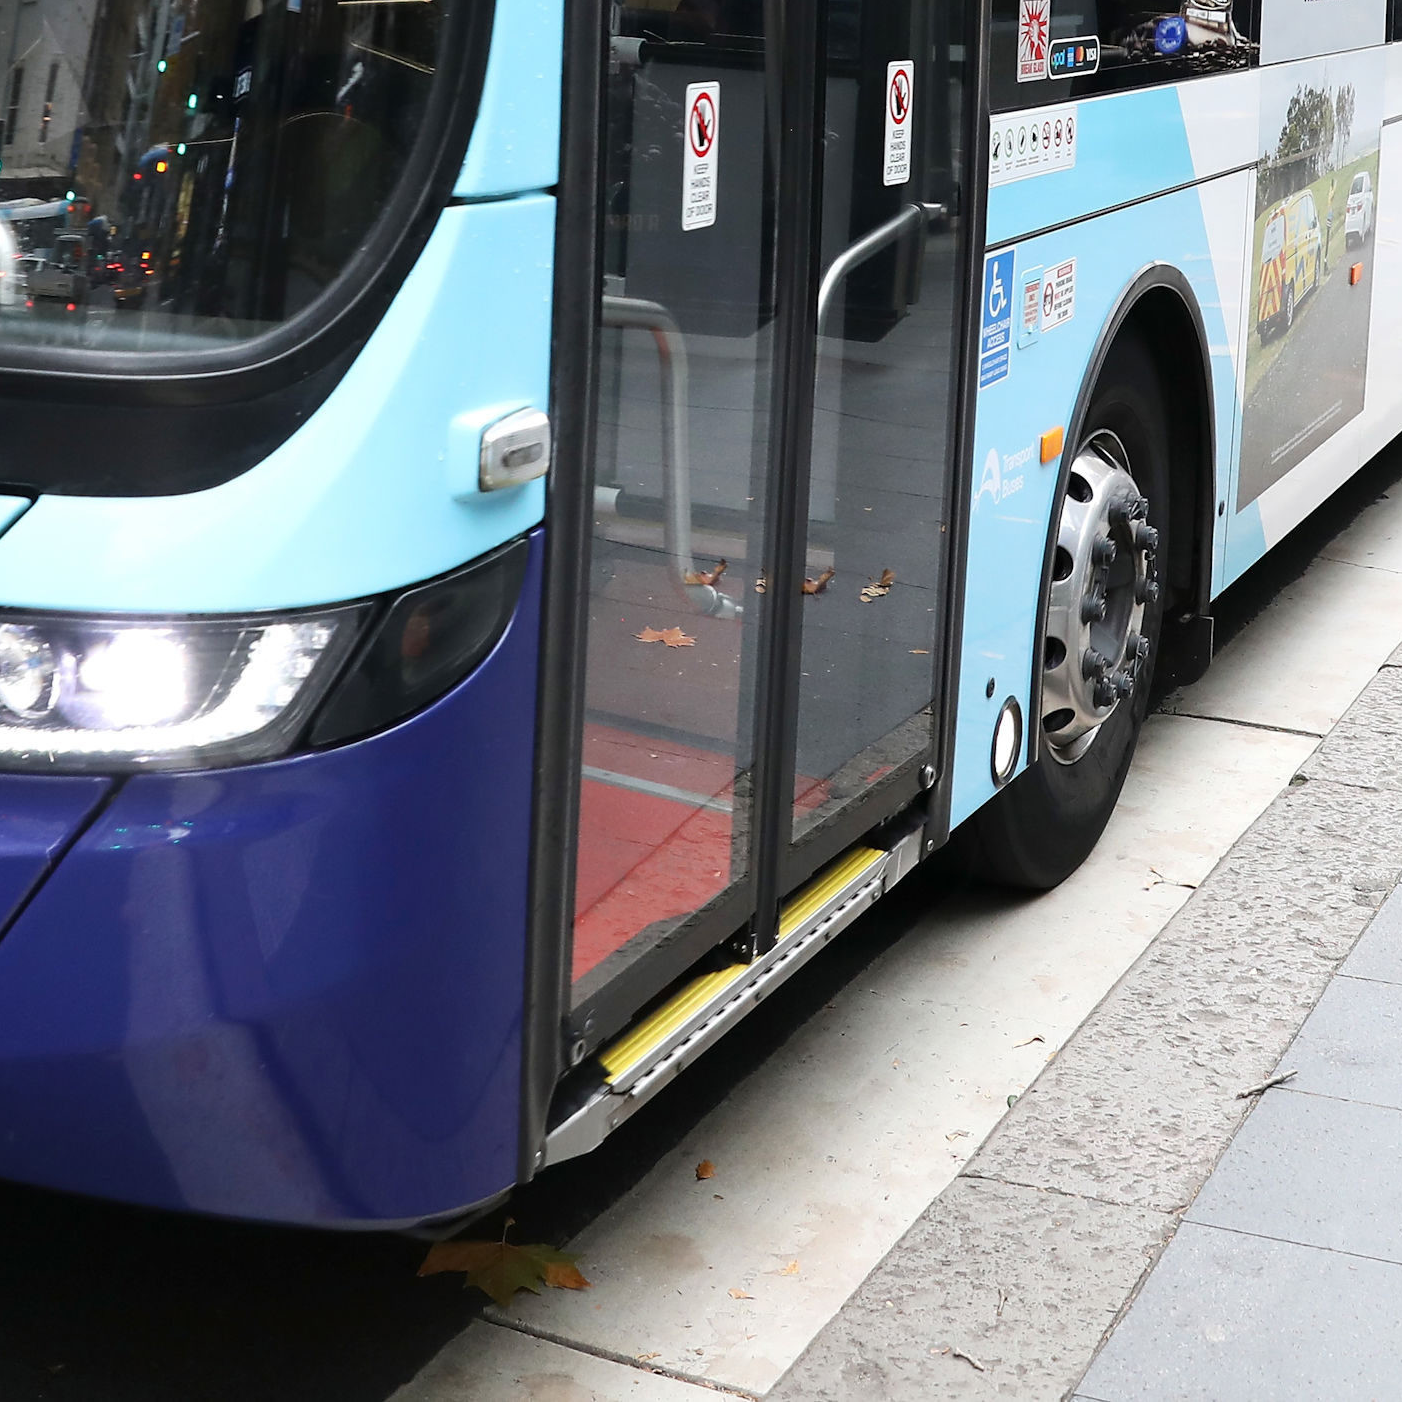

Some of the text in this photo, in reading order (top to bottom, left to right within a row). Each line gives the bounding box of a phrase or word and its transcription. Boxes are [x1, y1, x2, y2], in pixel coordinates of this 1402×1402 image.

[1086, 47, 1097, 61] VISA
[983, 317, 1010, 338] WHEELCHAIR
[986, 331, 1006, 349] ACCESS
[1002, 440, 1035, 473] Transport
[1002, 474, 1024, 499] Buses
